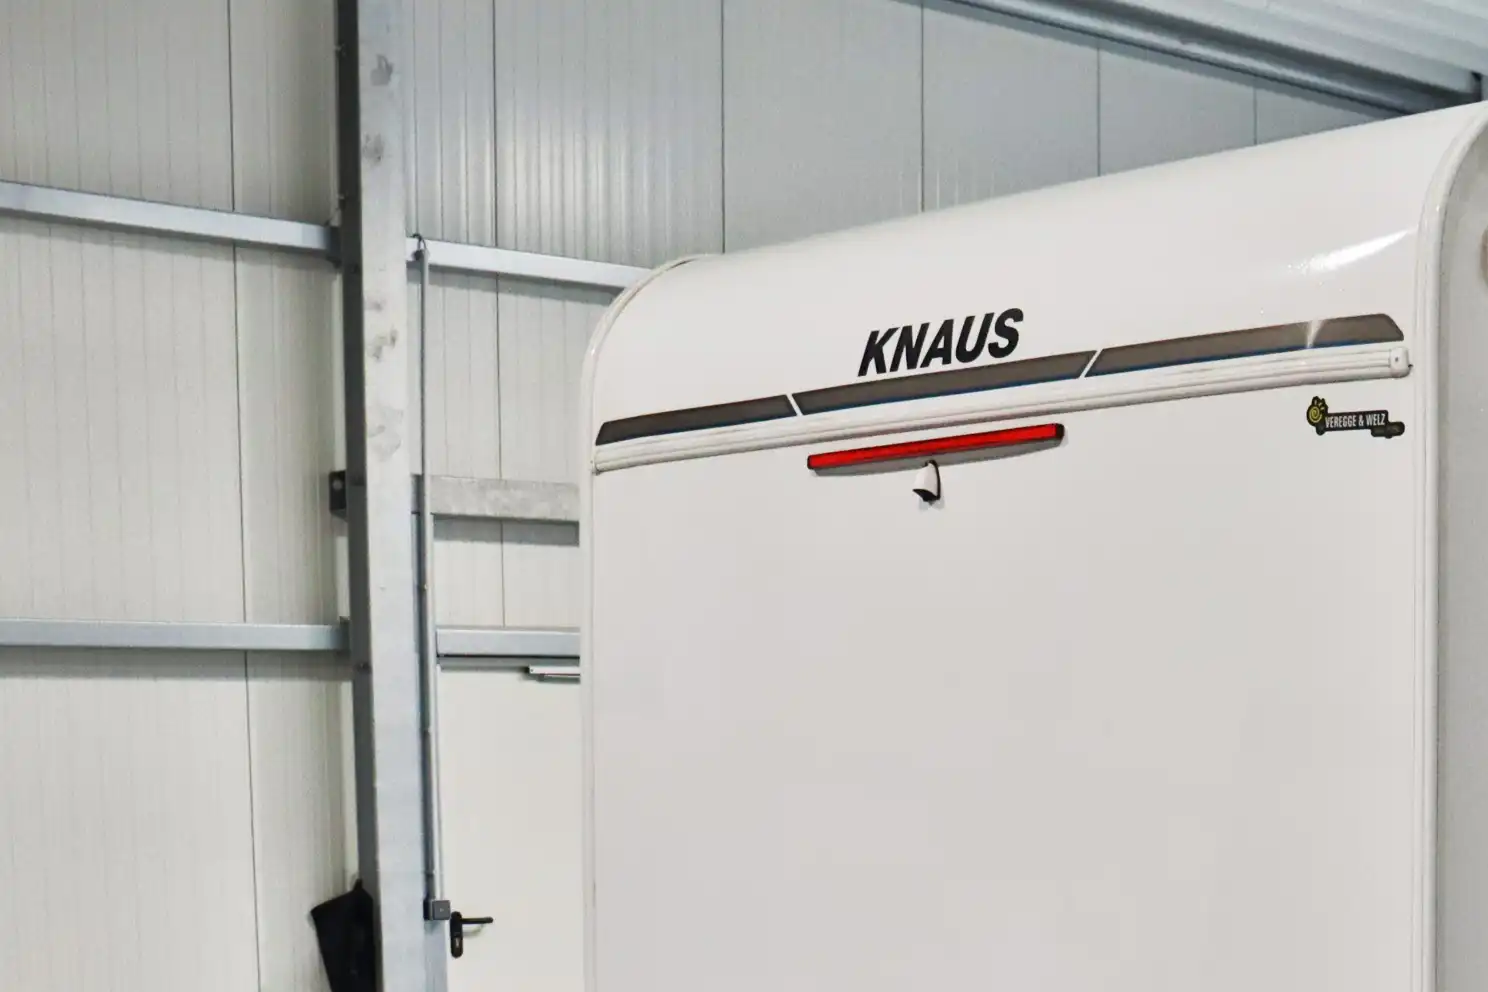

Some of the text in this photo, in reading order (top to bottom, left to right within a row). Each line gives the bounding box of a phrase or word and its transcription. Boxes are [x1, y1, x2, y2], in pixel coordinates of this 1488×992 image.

[857, 308, 1024, 377] KNAUS
[1325, 412, 1386, 429] VEREGGE & WELZ
